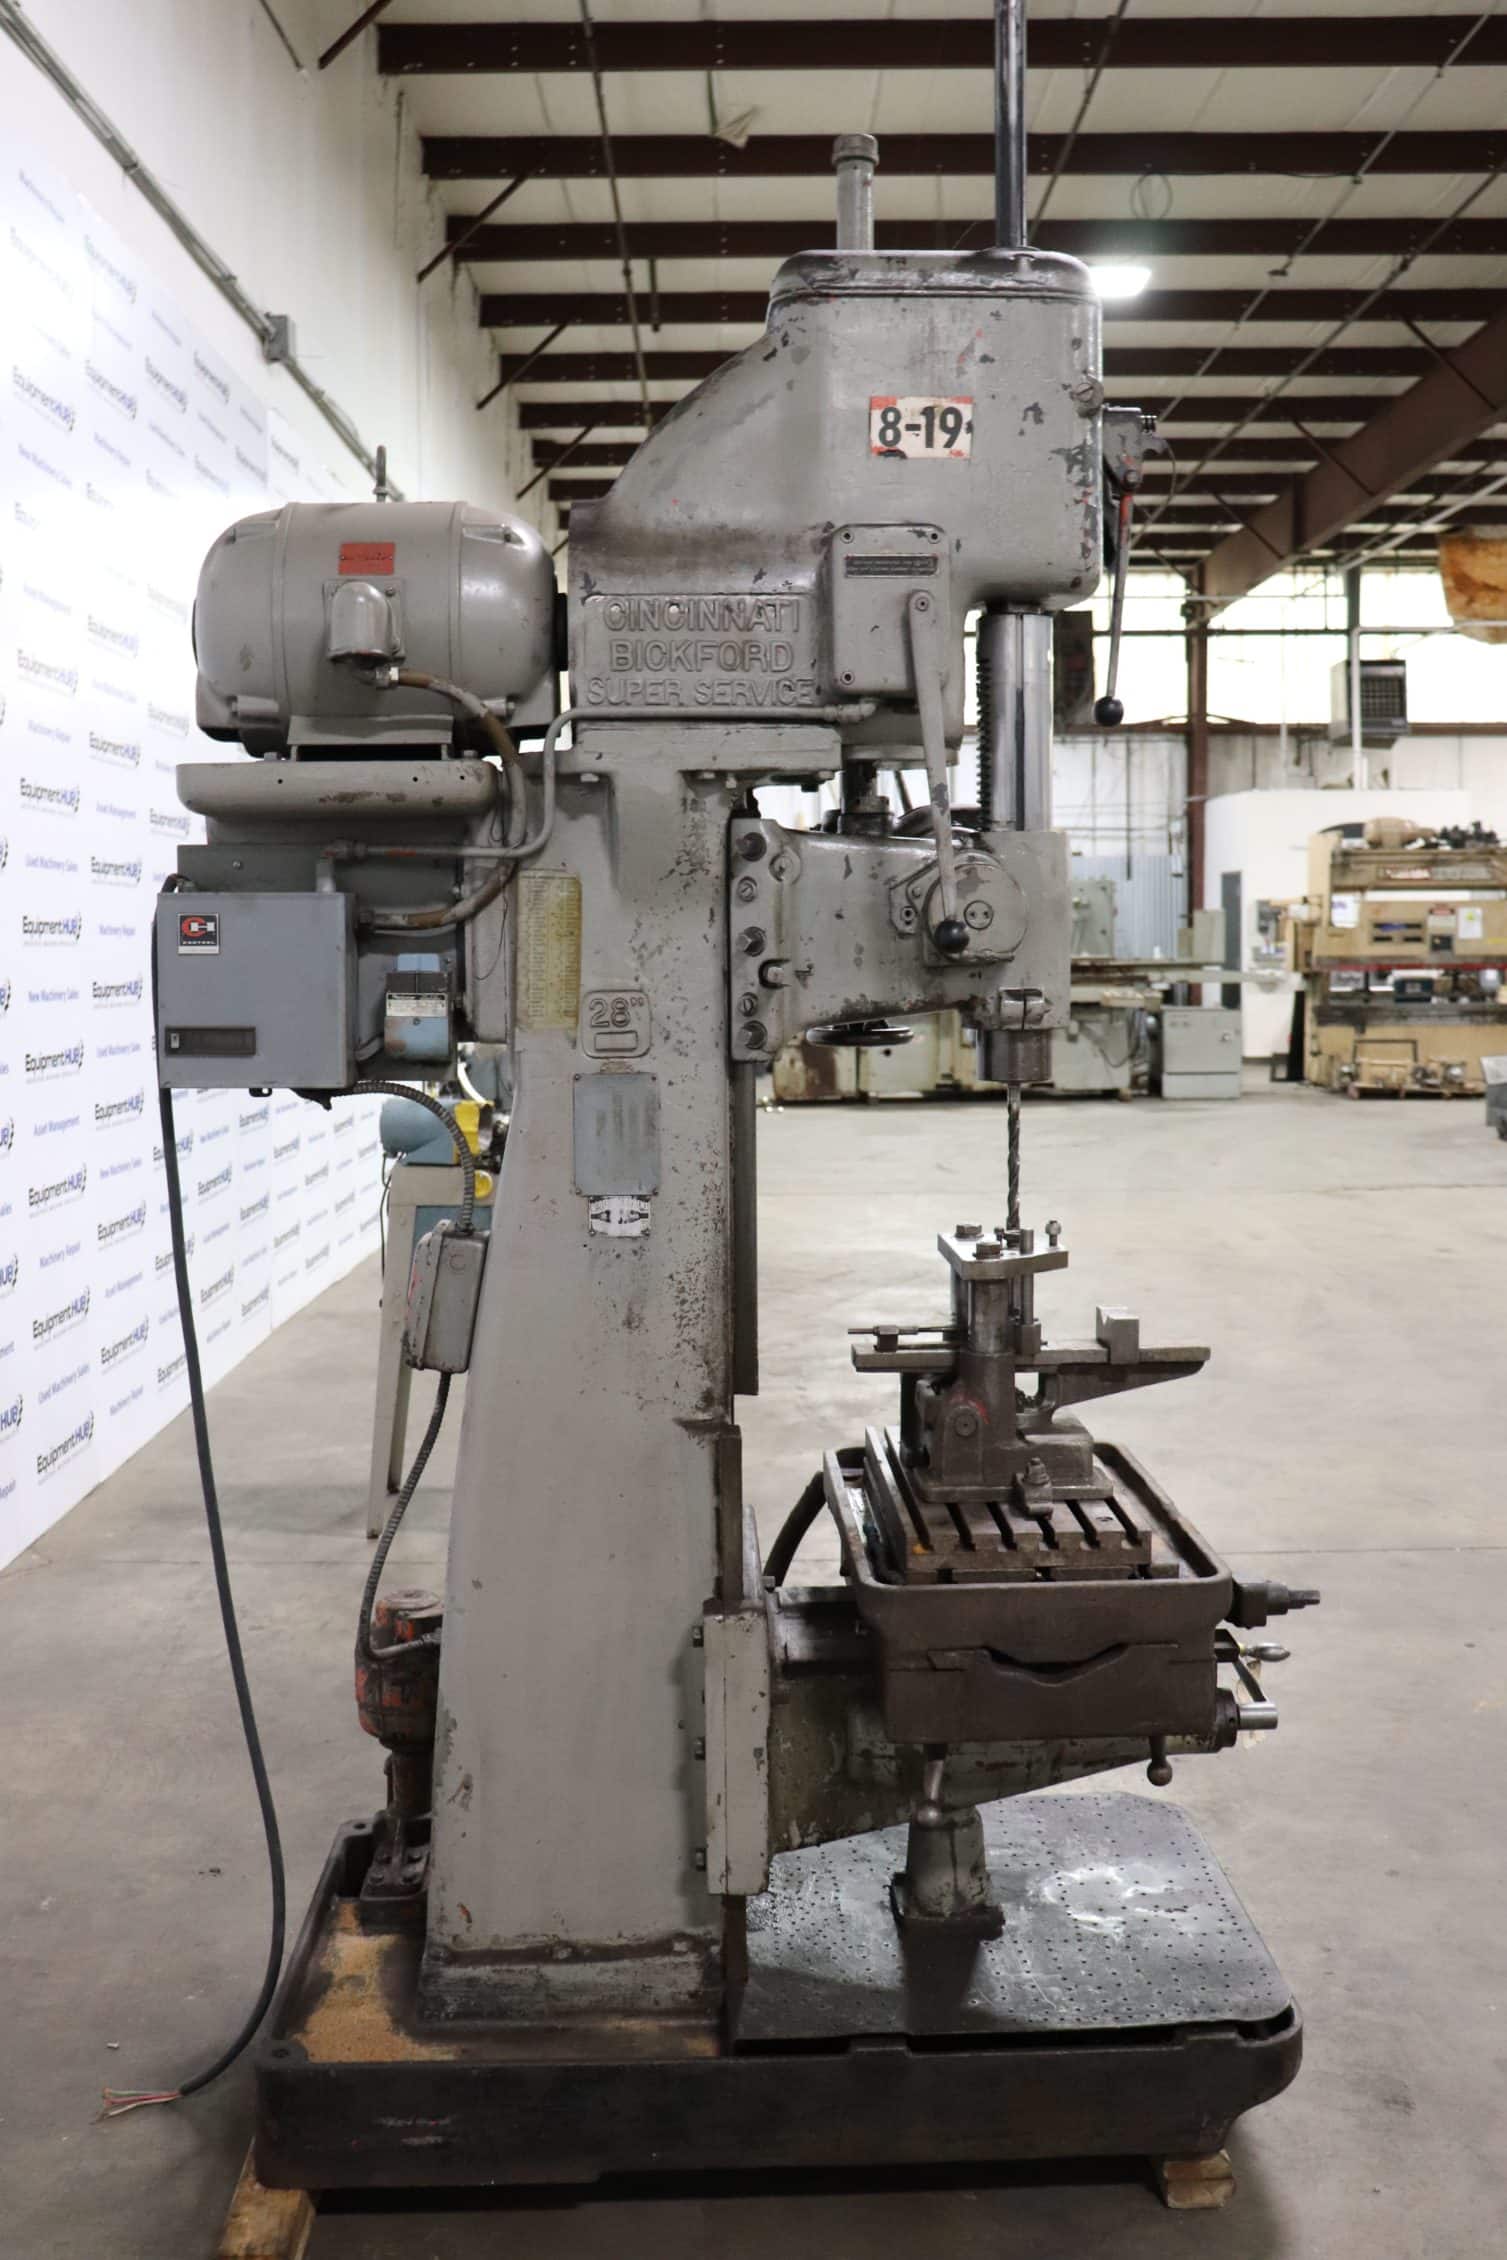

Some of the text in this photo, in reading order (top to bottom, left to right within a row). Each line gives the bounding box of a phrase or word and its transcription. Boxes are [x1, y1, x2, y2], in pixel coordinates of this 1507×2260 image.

[879, 406, 963, 448] 8-19
[602, 600, 800, 632] CINCINNATI
[609, 639, 793, 673] BICKFORD
[586, 677, 815, 706] SUPER SERVICE
[36, 1419, 91, 1475] EquipmentHUB
